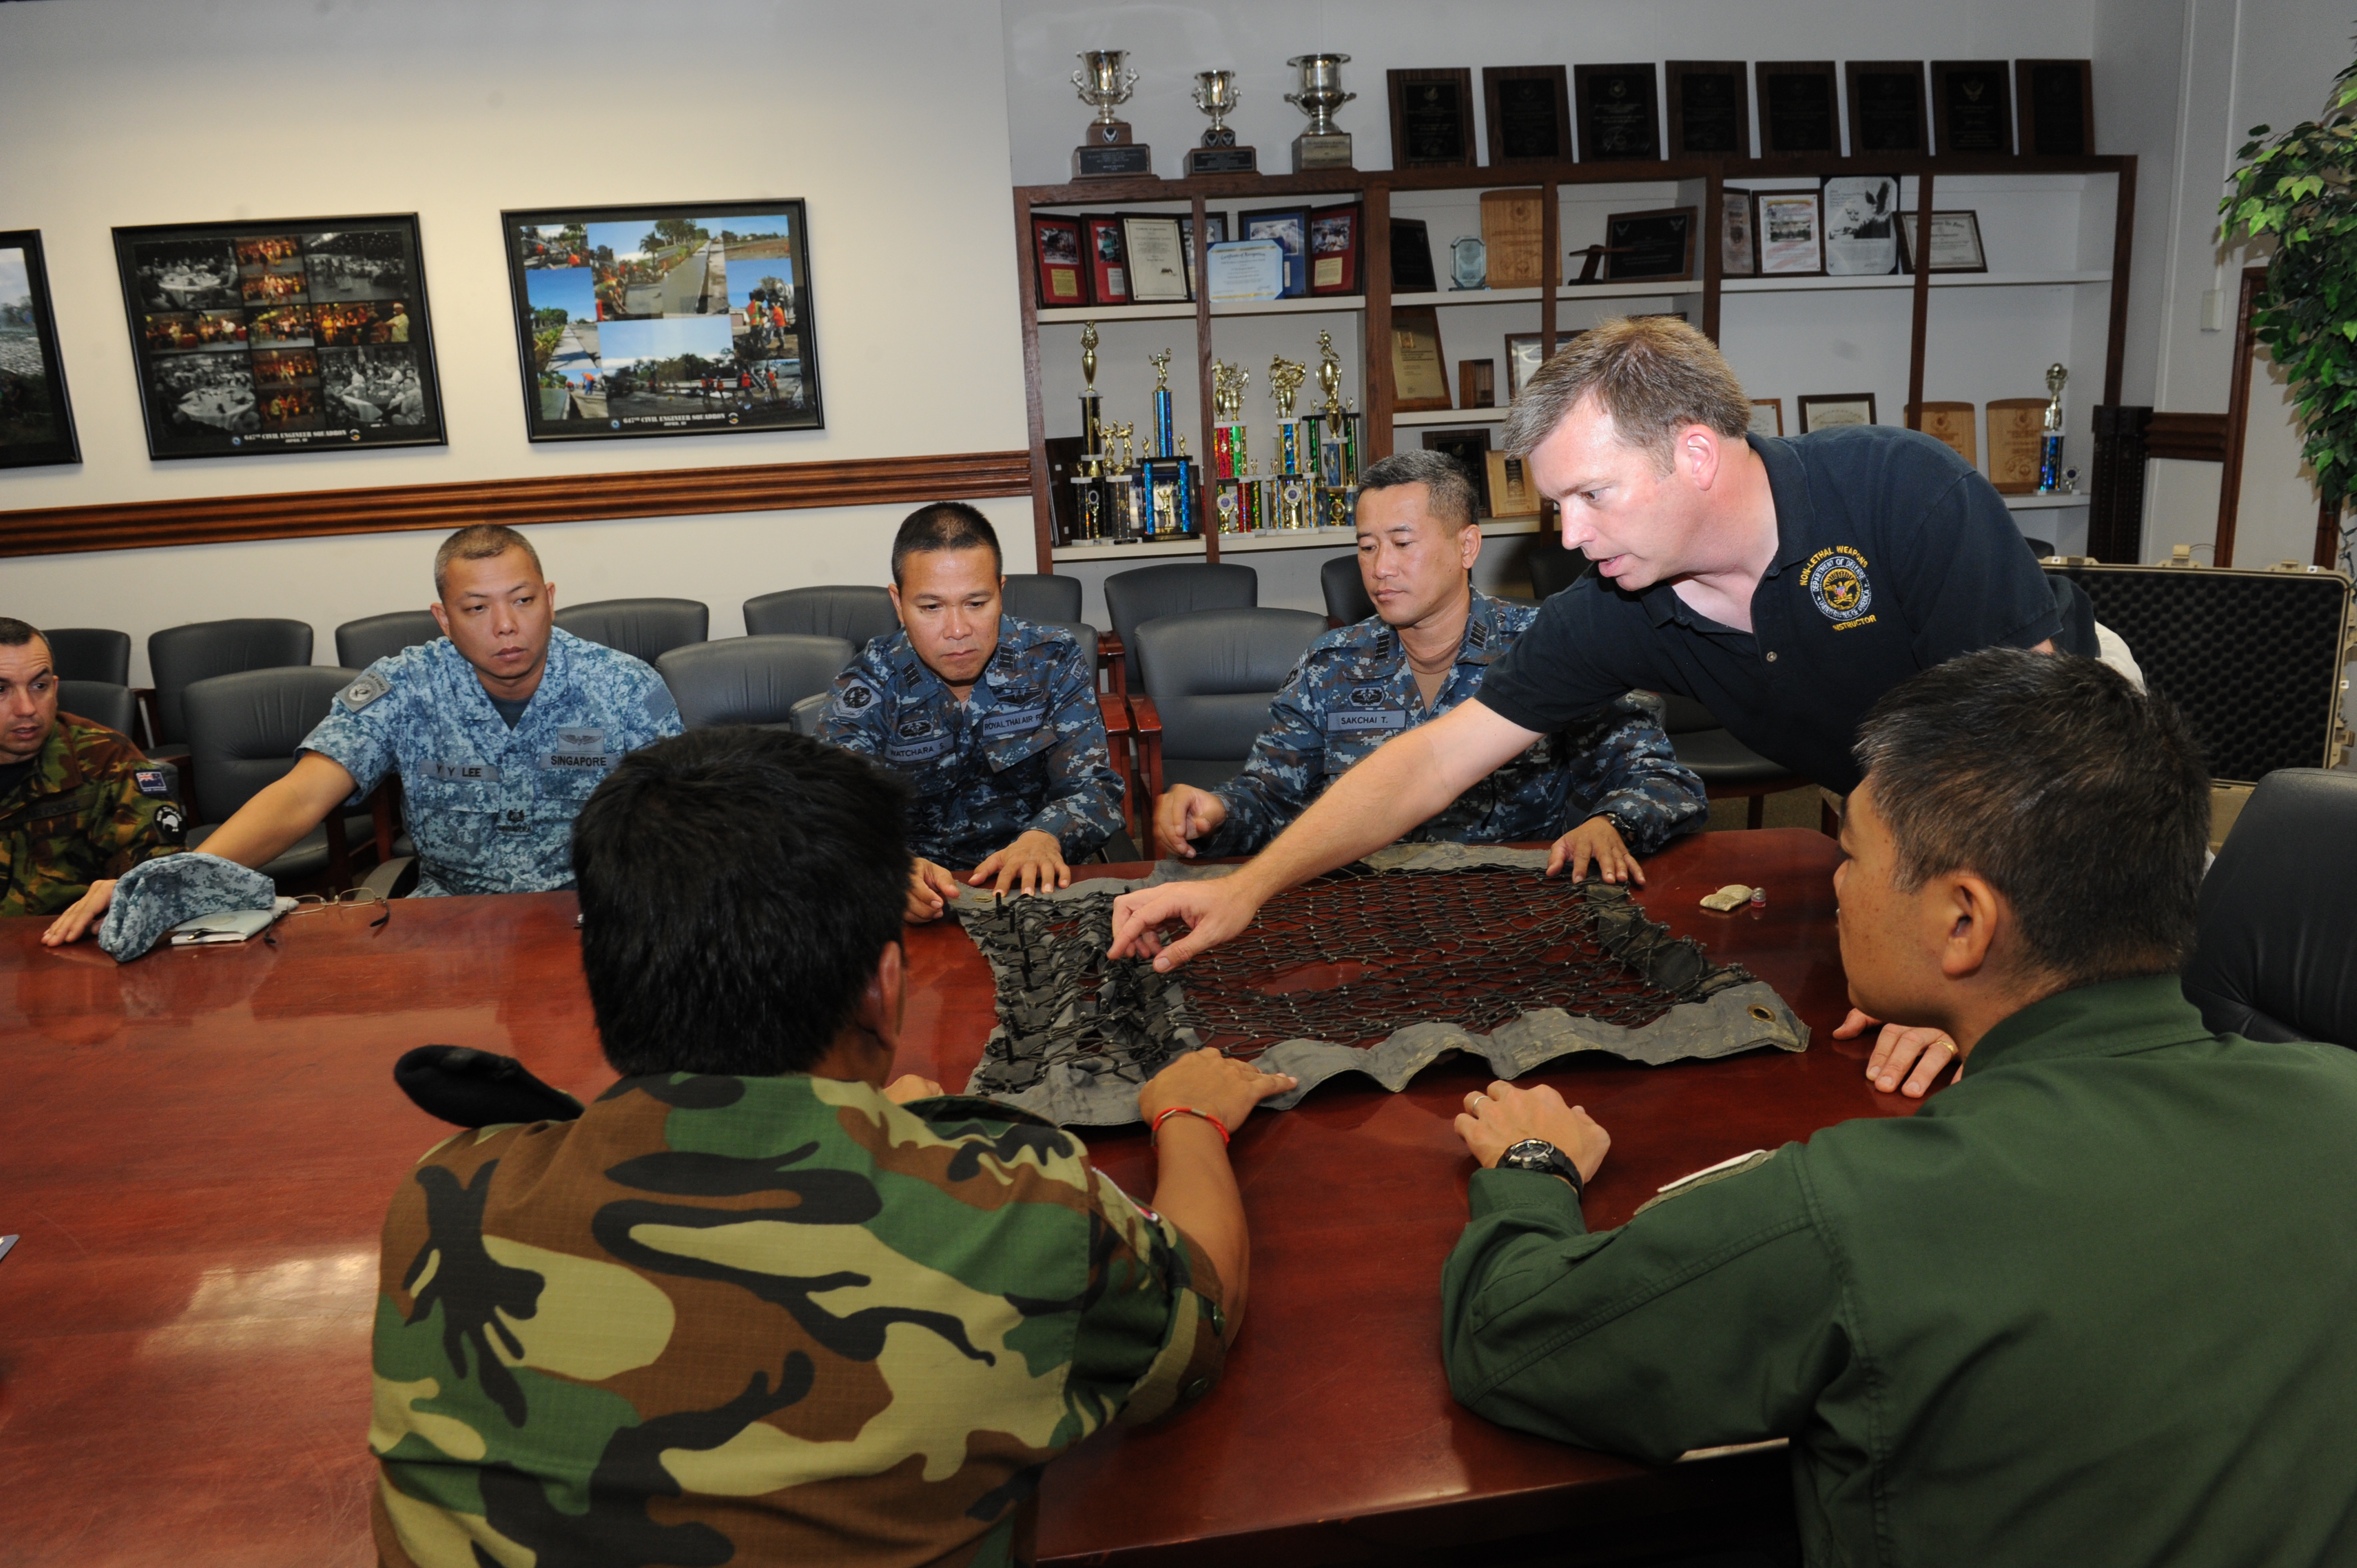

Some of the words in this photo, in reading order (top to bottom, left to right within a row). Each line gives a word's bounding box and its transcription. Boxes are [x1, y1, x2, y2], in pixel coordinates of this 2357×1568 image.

[1799, 546, 1834, 586] NON-LETHAL
[1836, 545, 1869, 568] WEAPONS
[1812, 559, 1834, 592] DEPARTMENT
[984, 721, 1006, 731] ROYAL
[1005, 718, 1021, 727] THAI
[1022, 715, 1033, 724] AIR
[1341, 716, 1377, 725] SAKCHAI
[890, 746, 934, 757] WATCHARA
[550, 755, 607, 767] SINGAPORE
[436, 764, 442, 773] Y
[447, 767, 455, 776] Y
[462, 767, 482, 777] LEE
